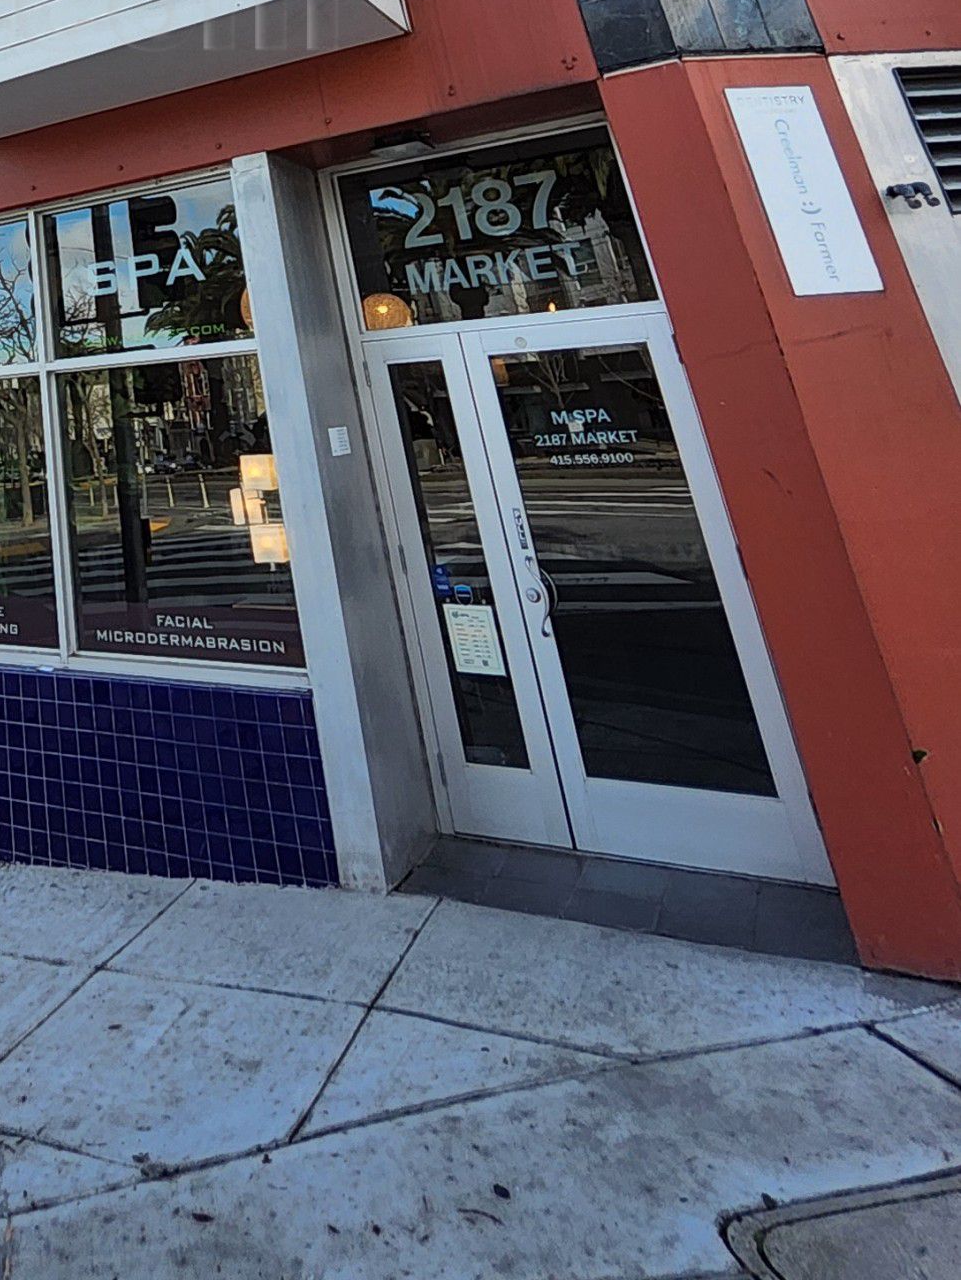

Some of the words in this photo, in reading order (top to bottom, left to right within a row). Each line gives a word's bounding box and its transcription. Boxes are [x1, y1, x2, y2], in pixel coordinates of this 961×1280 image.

[404, 170, 557, 249] 2187
[774, 119, 809, 195] Creelman
[810, 221, 841, 281] Farmer
[87, 247, 206, 296] SPA
[405, 241, 582, 295] MARKET
[534, 434, 567, 446] 2187
[571, 430, 638, 445] MARKET
[550, 453, 634, 465] 415.556.9100
[156, 615, 214, 630] FACIAL
[96, 629, 286, 655] MICRODERMABRASION
